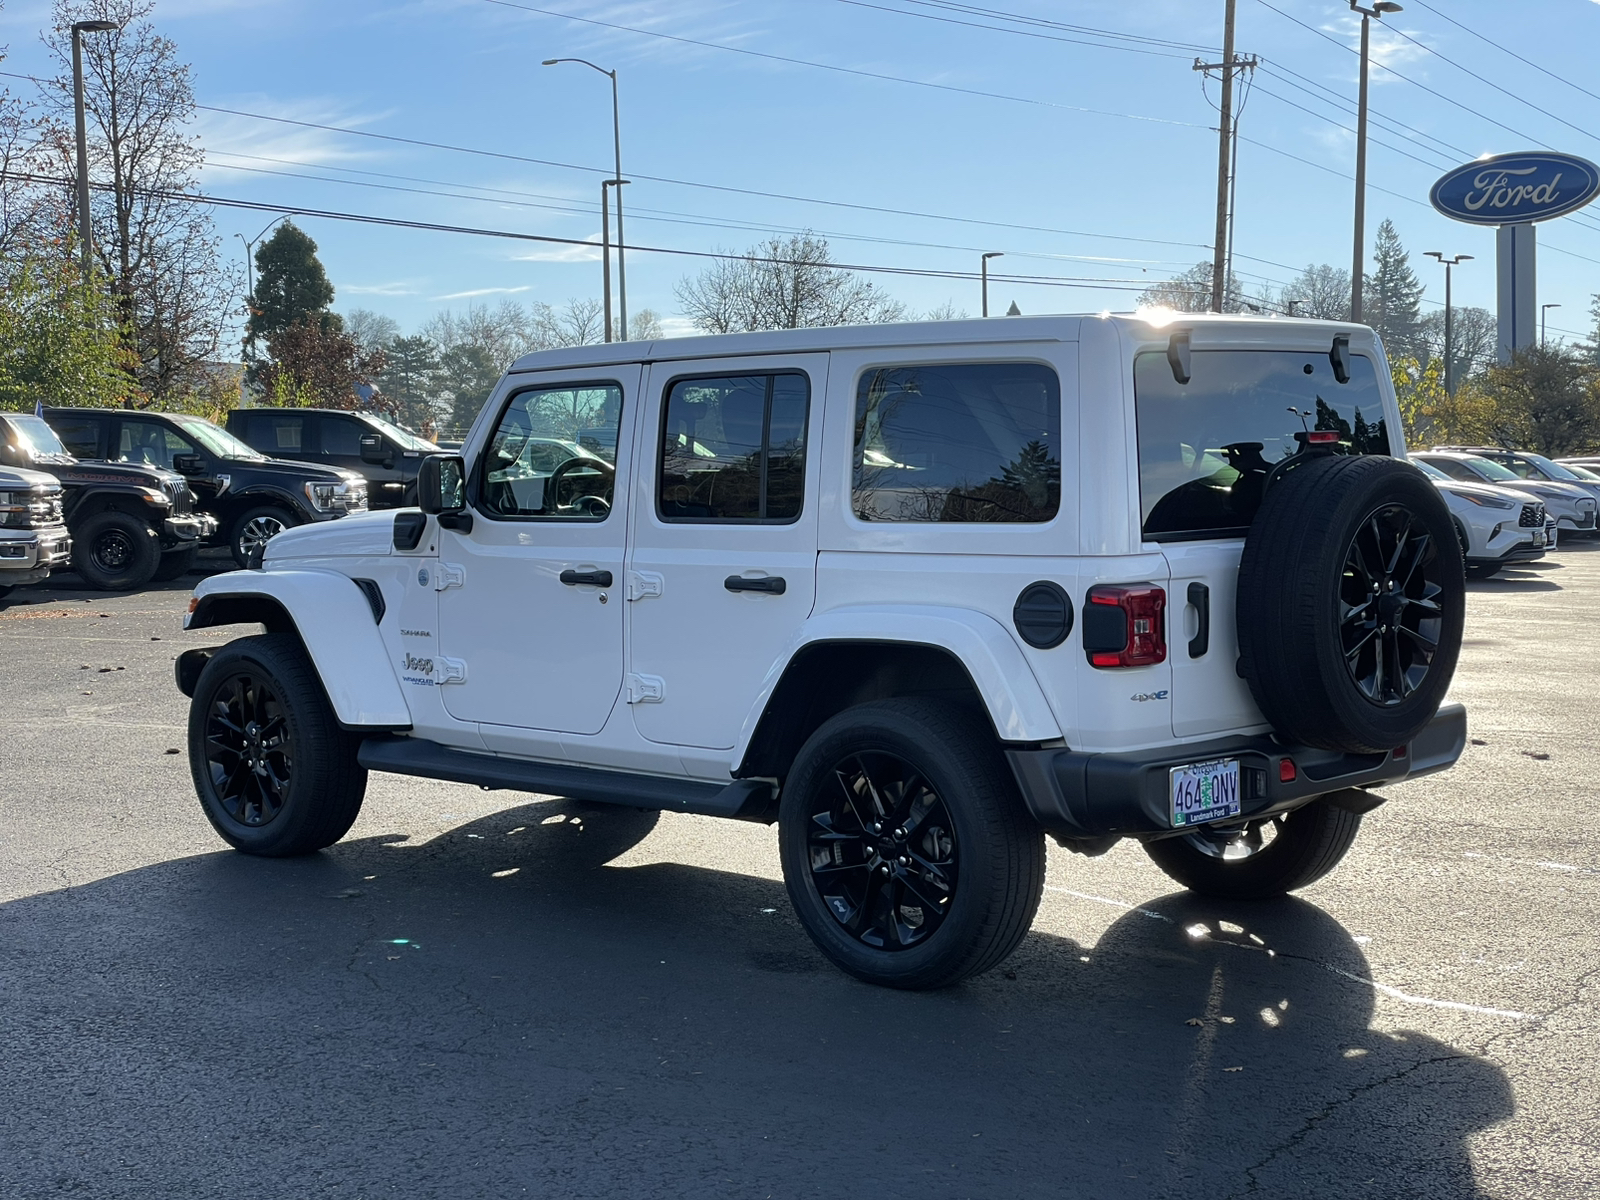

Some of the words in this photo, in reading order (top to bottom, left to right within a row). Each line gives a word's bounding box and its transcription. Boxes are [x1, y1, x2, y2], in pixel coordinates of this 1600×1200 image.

[1464, 166, 1563, 211] Ford
[67, 472, 145, 484] MOJAVE
[400, 629, 432, 637] SAHARA
[401, 652, 433, 675] Jeep
[1175, 778, 1201, 811] 464
[1211, 771, 1237, 805] QNV
[1190, 810, 1213, 822] Landmark
[1213, 808, 1225, 817] Ford
